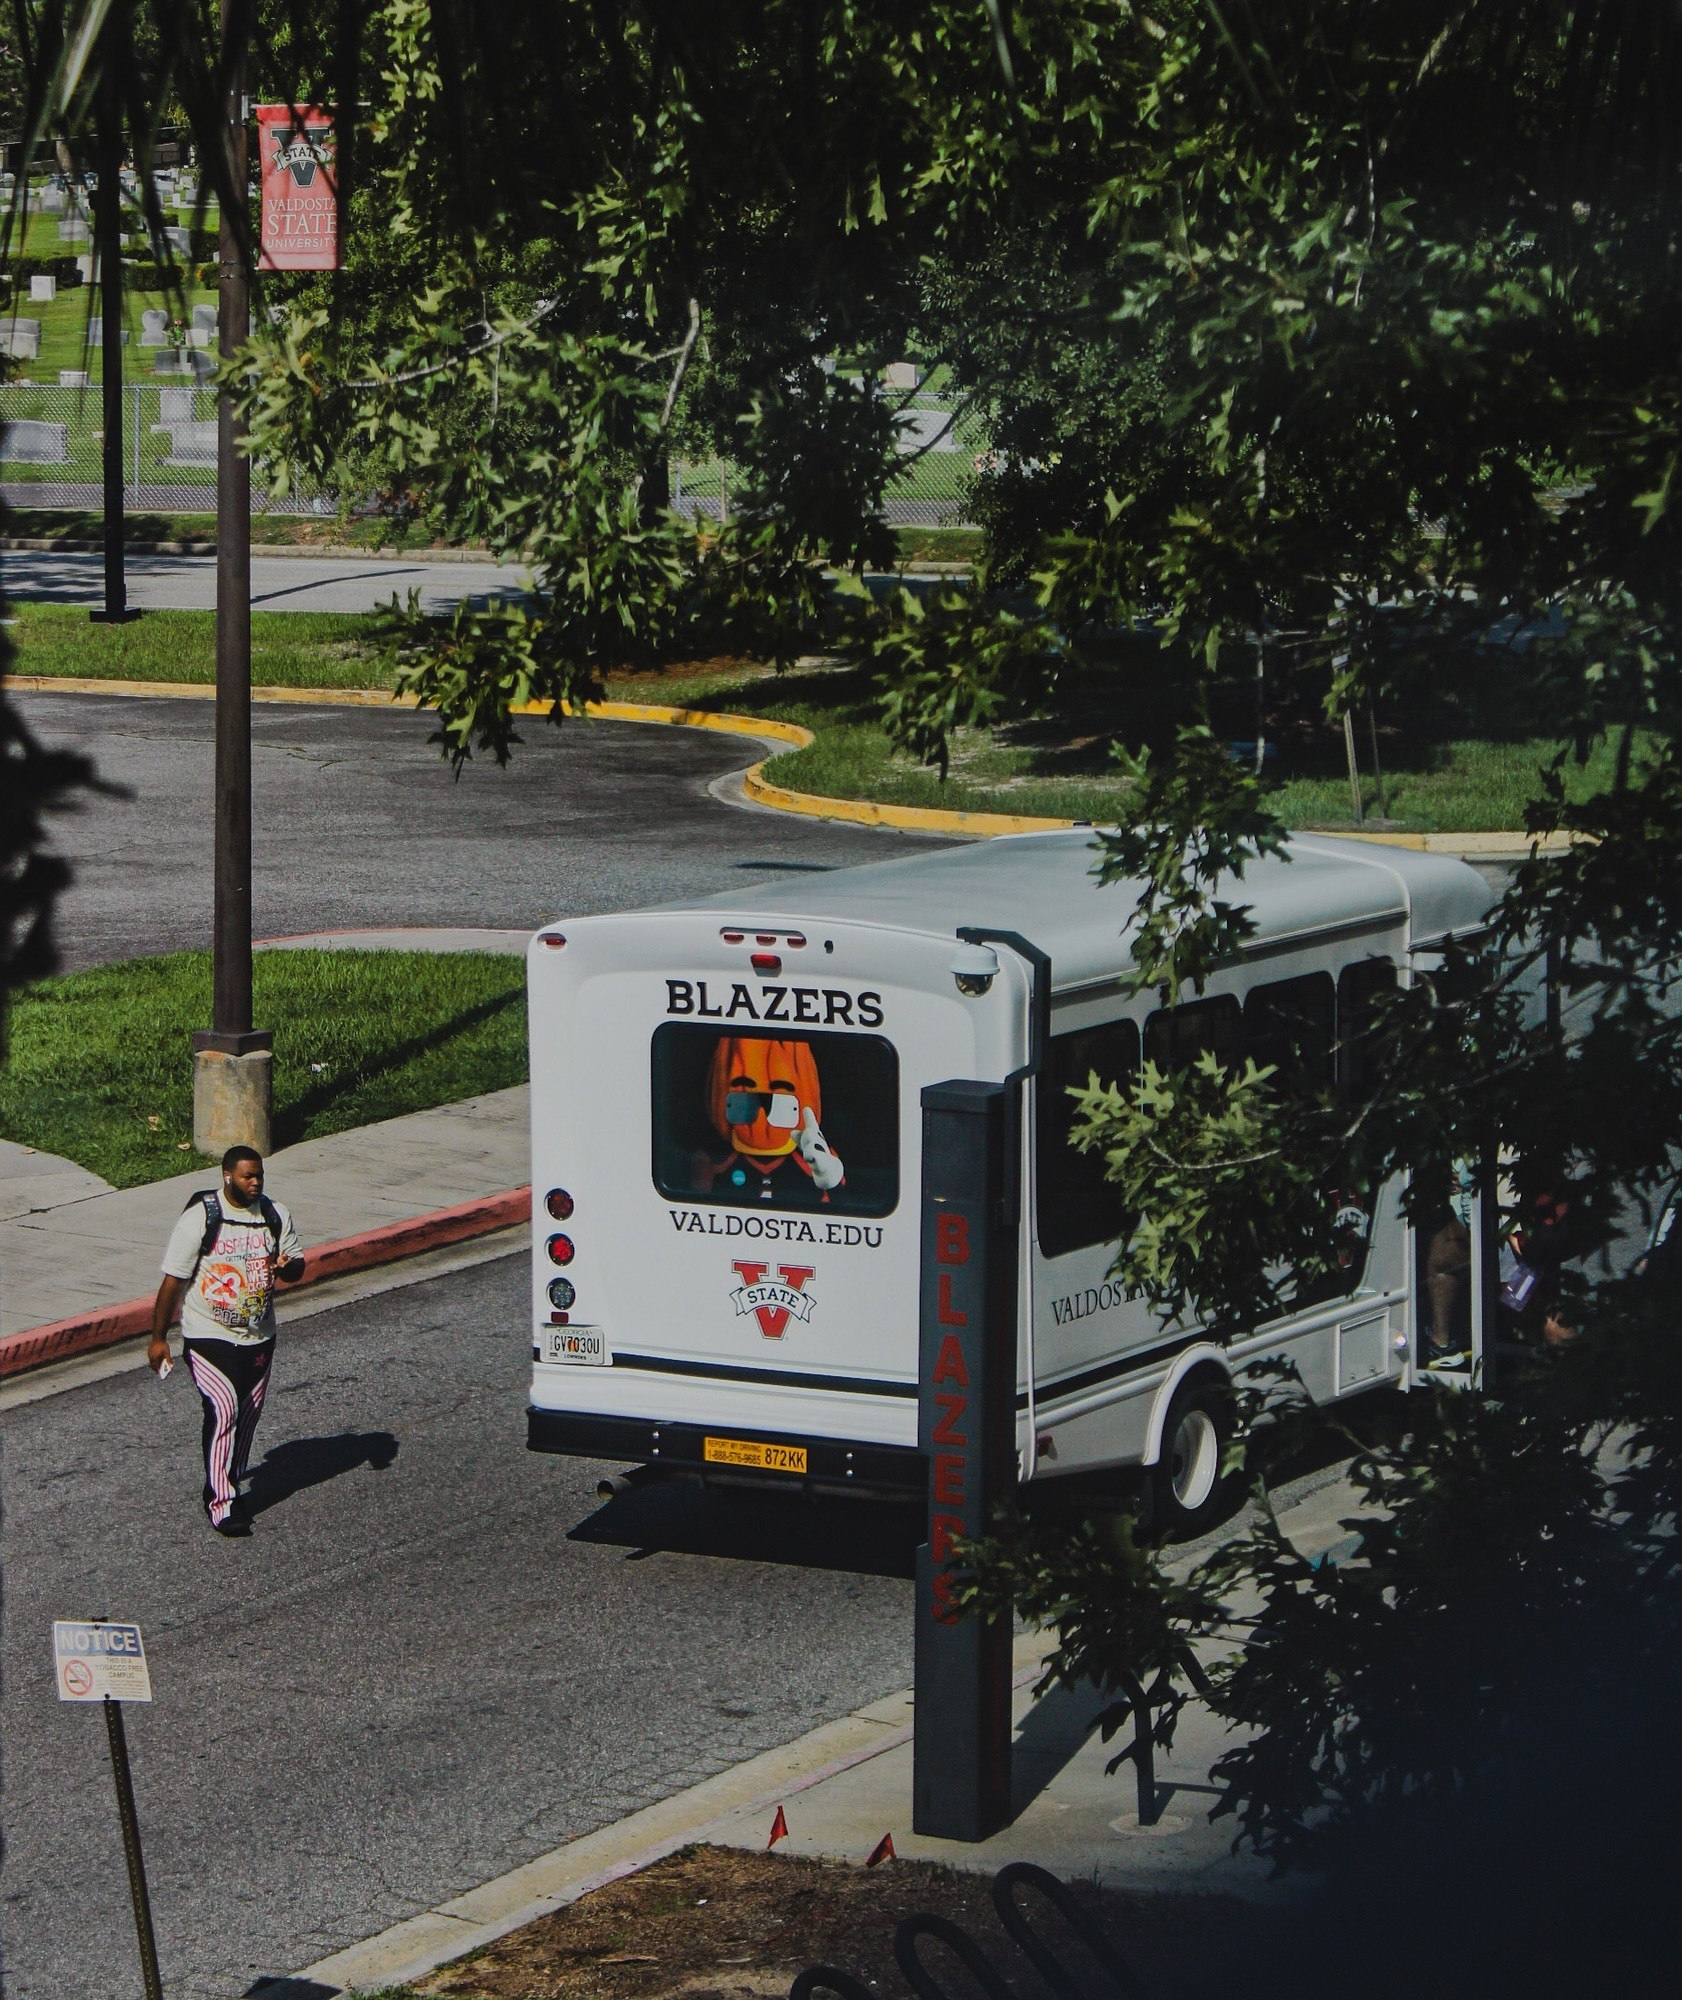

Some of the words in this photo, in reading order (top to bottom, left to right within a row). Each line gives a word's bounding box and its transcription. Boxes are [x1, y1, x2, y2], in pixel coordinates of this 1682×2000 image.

[268, 197, 336, 211] VALDOSTA
[267, 213, 337, 235] STATE
[266, 237, 337, 248] UNIVERSITY
[665, 979, 884, 1028] BLAZERS
[669, 1210, 883, 1248] VALDOSTA.EDU
[246, 1259, 266, 1271] STOP
[747, 1287, 800, 1309] STATE
[554, 1335, 600, 1355] GV7030U
[932, 1213, 971, 1625] BLAZERS
[765, 1448, 804, 1469] 872KK
[60, 1629, 138, 1652] NOTICE
